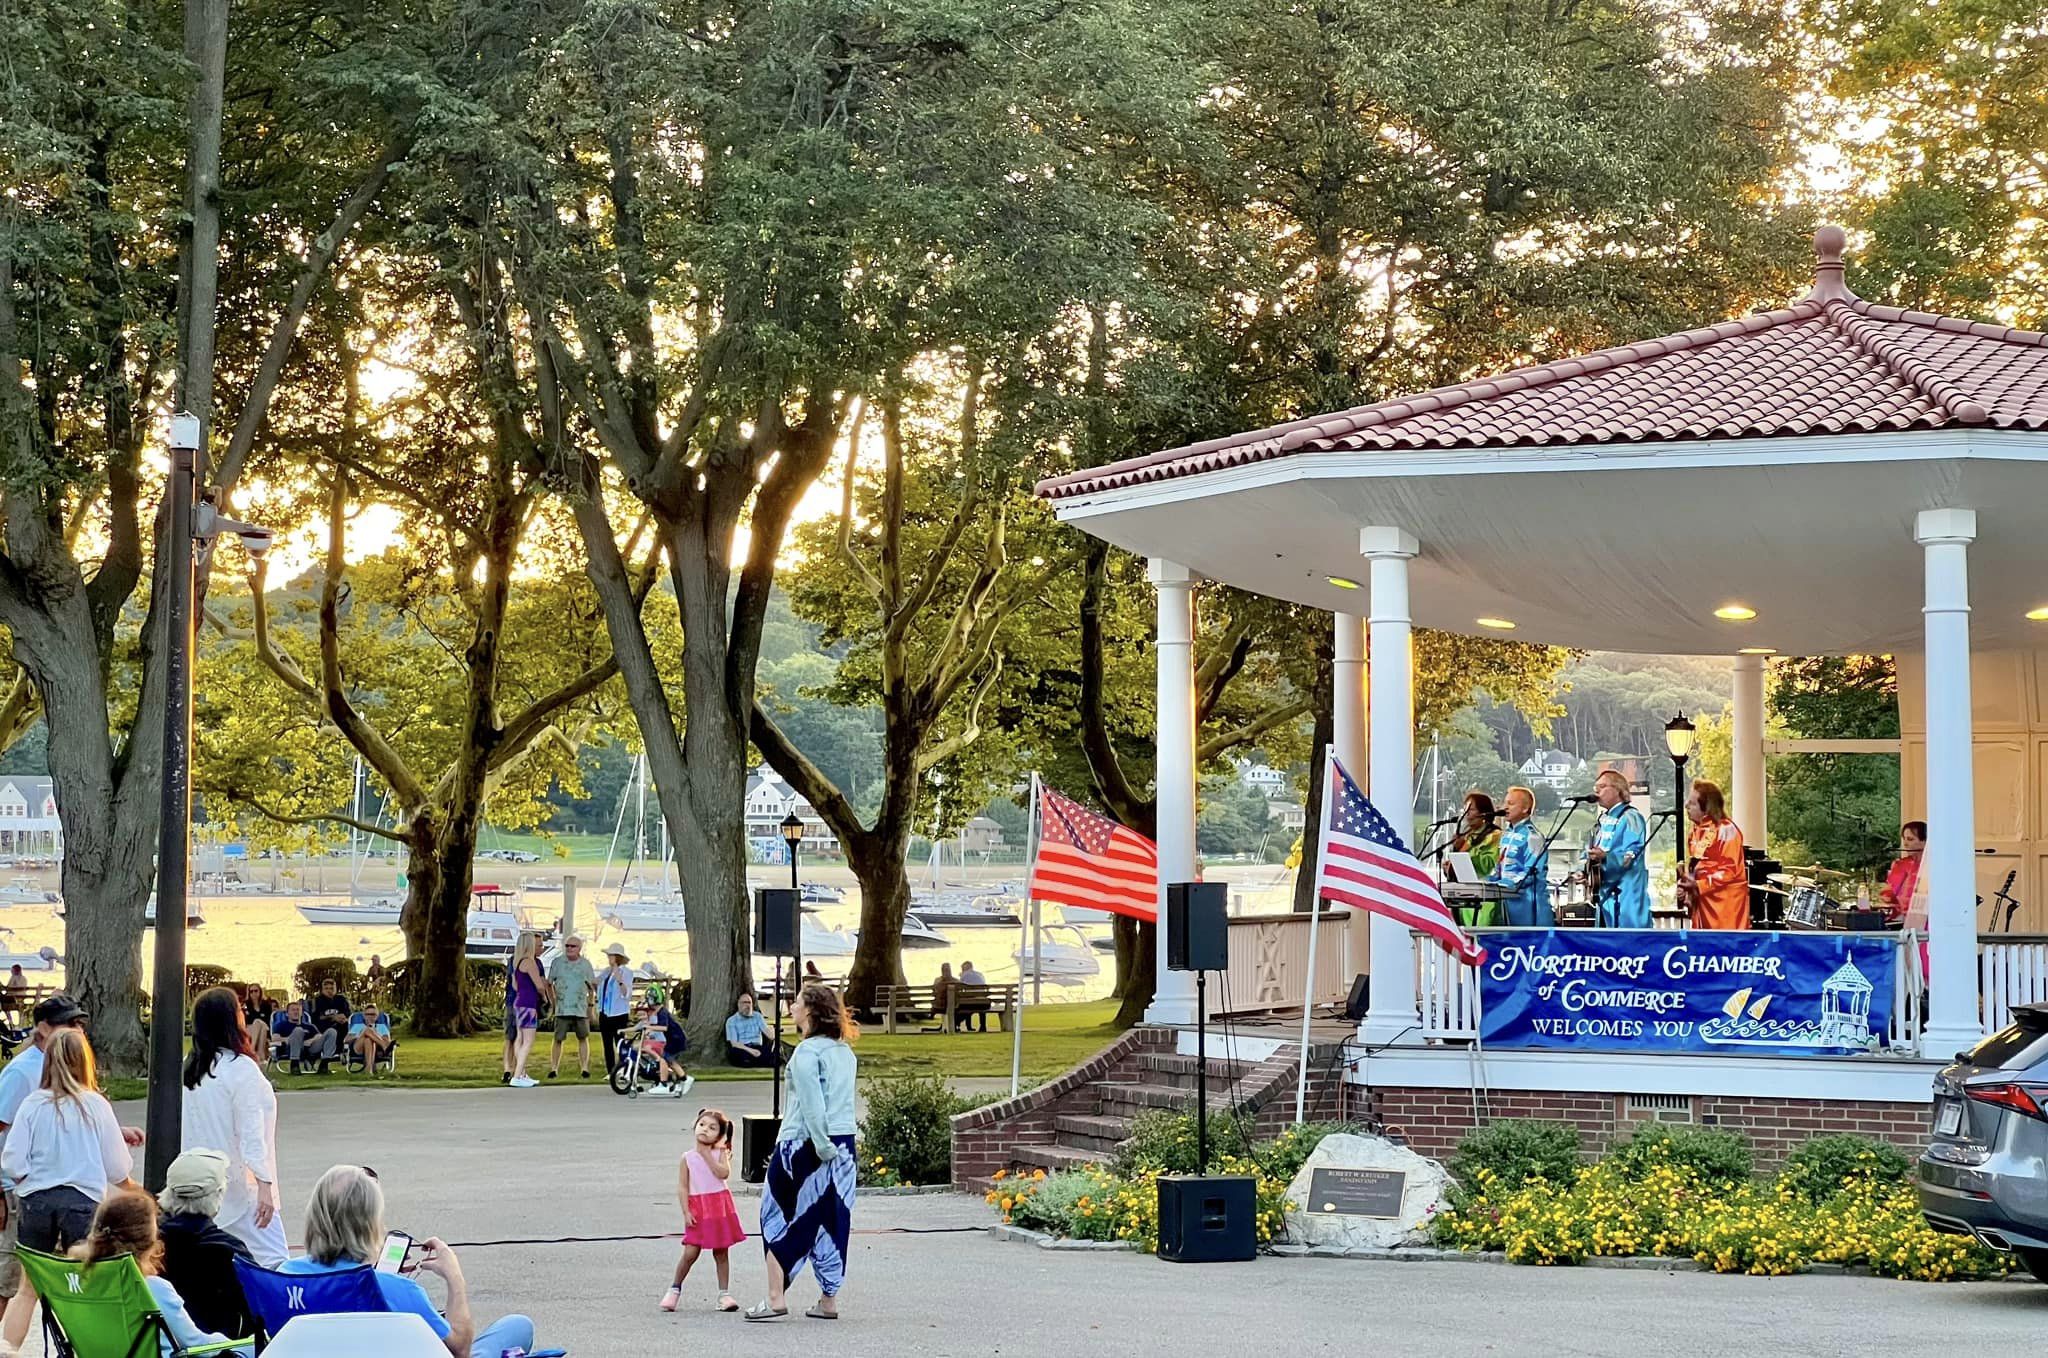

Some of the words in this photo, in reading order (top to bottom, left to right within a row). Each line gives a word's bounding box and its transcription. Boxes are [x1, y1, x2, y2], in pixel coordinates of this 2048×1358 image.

[1489, 945, 1650, 981] NORTHPORT
[1662, 945, 1786, 980] CHAMBER
[1538, 980, 1558, 1000] of
[1561, 979, 1686, 1014] COMMERCE
[1532, 1019, 1644, 1037] WELCOMES
[1653, 1021, 1695, 1037] YOU
